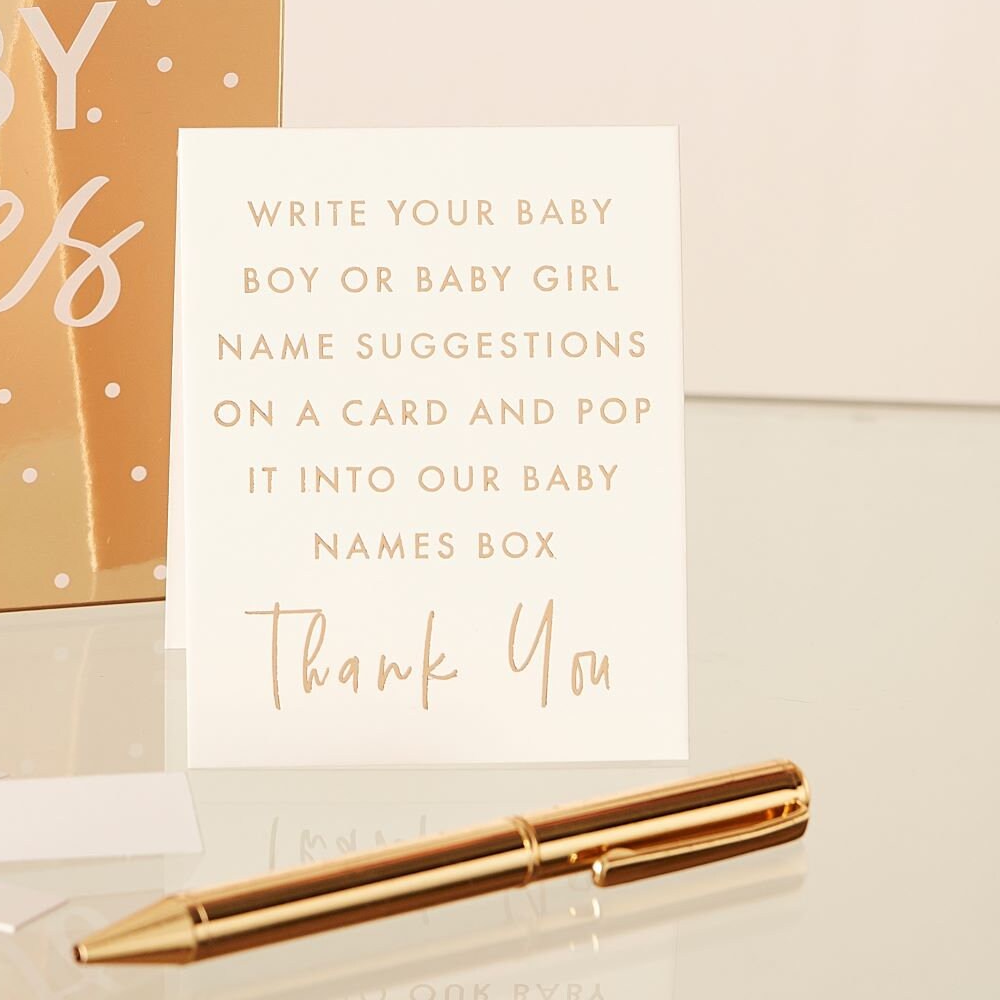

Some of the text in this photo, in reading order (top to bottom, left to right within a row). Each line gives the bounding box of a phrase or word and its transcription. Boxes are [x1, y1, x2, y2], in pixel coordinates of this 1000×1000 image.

[247, 198, 612, 228] WRITE YOUR BABY
[243, 264, 620, 294] BOY OR BABY GIRL
[217, 330, 647, 361] NAME SUGGESTIONS
[213, 397, 652, 428] ON A CARD AND POP
[247, 464, 619, 494] IT INTO OUR BABY
[313, 531, 557, 561] NAMES BOX
[244, 598, 611, 711] Thank You
